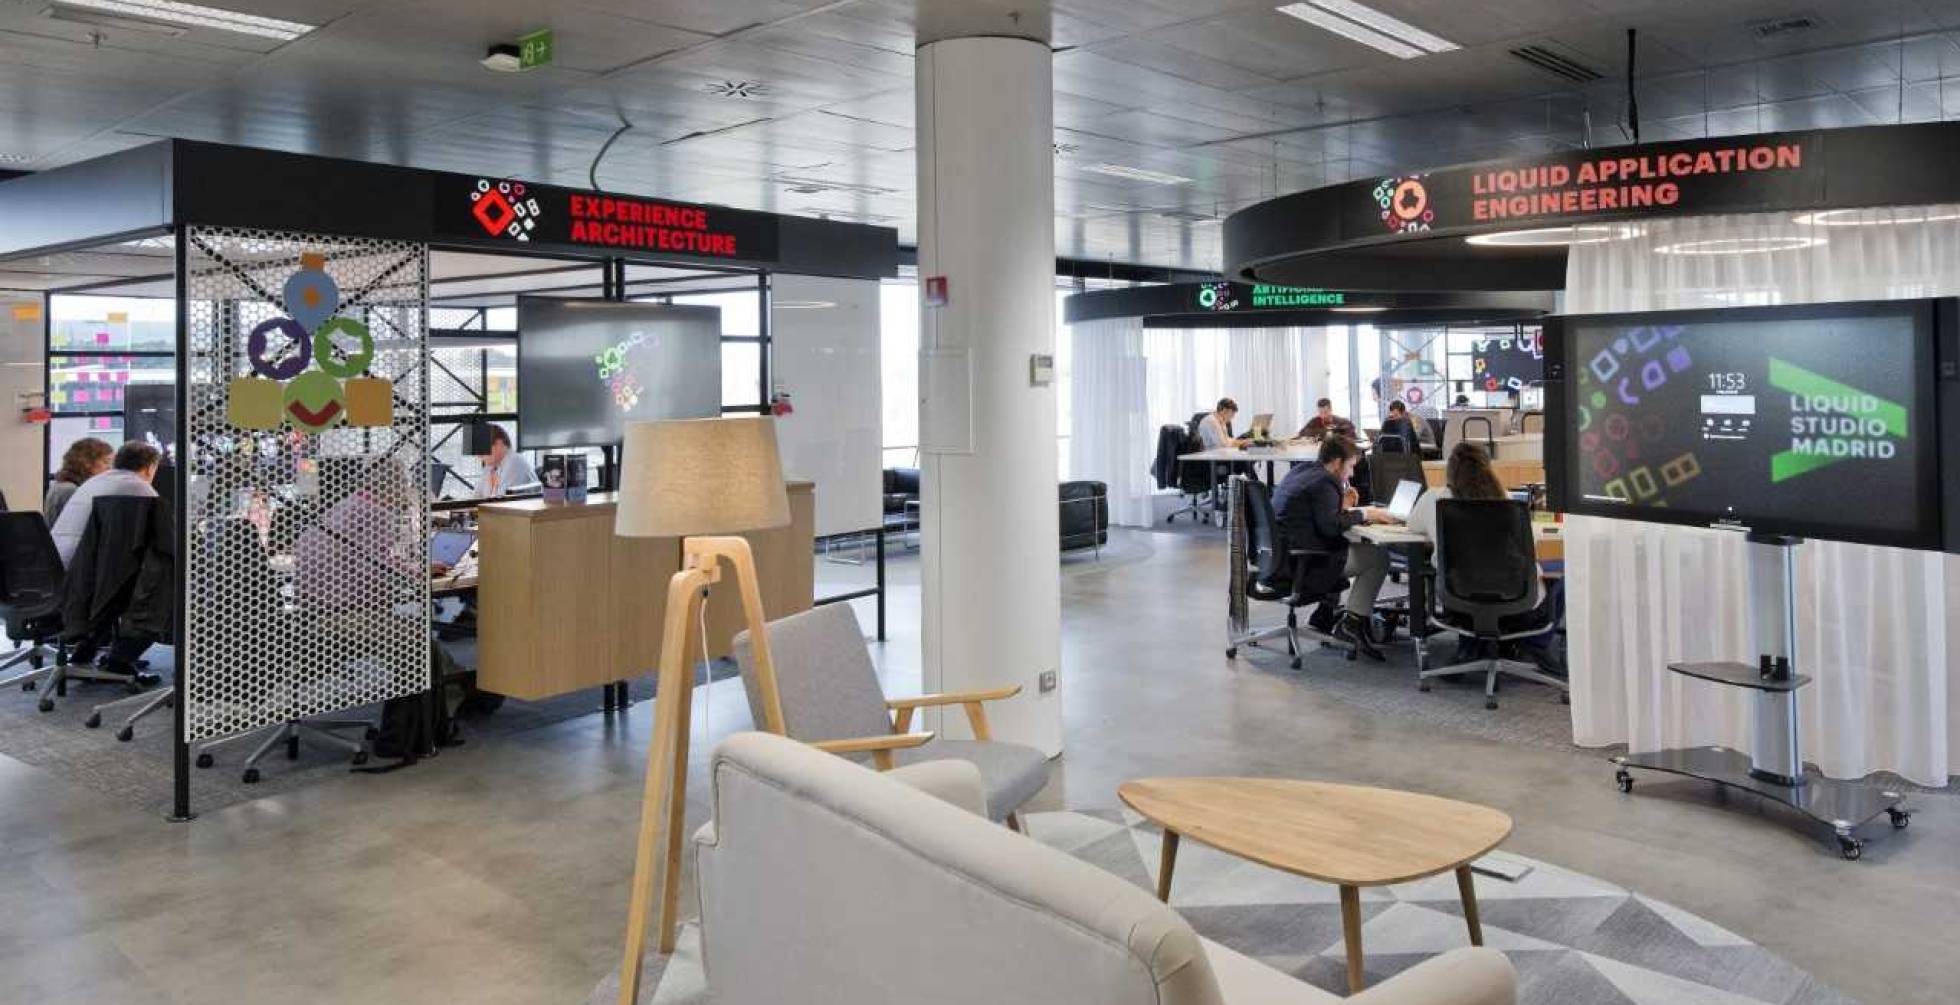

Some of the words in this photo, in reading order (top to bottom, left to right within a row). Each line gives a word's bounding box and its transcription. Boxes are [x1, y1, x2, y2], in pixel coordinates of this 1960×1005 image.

[1473, 165, 1570, 194] LIQUID
[1578, 145, 1800, 182] APPLICATION
[570, 195, 707, 228] EXPERIENCE
[1473, 184, 1679, 219] ENGINEERING
[570, 222, 736, 254] ARCHITECTURE
[1253, 294, 1344, 306] INTELLIGENCE
[1708, 372, 1745, 390] 11:53
[1790, 394, 1878, 413] LIQUID
[1790, 416, 1887, 437] STUDIO
[1791, 437, 1896, 459] MADRID
